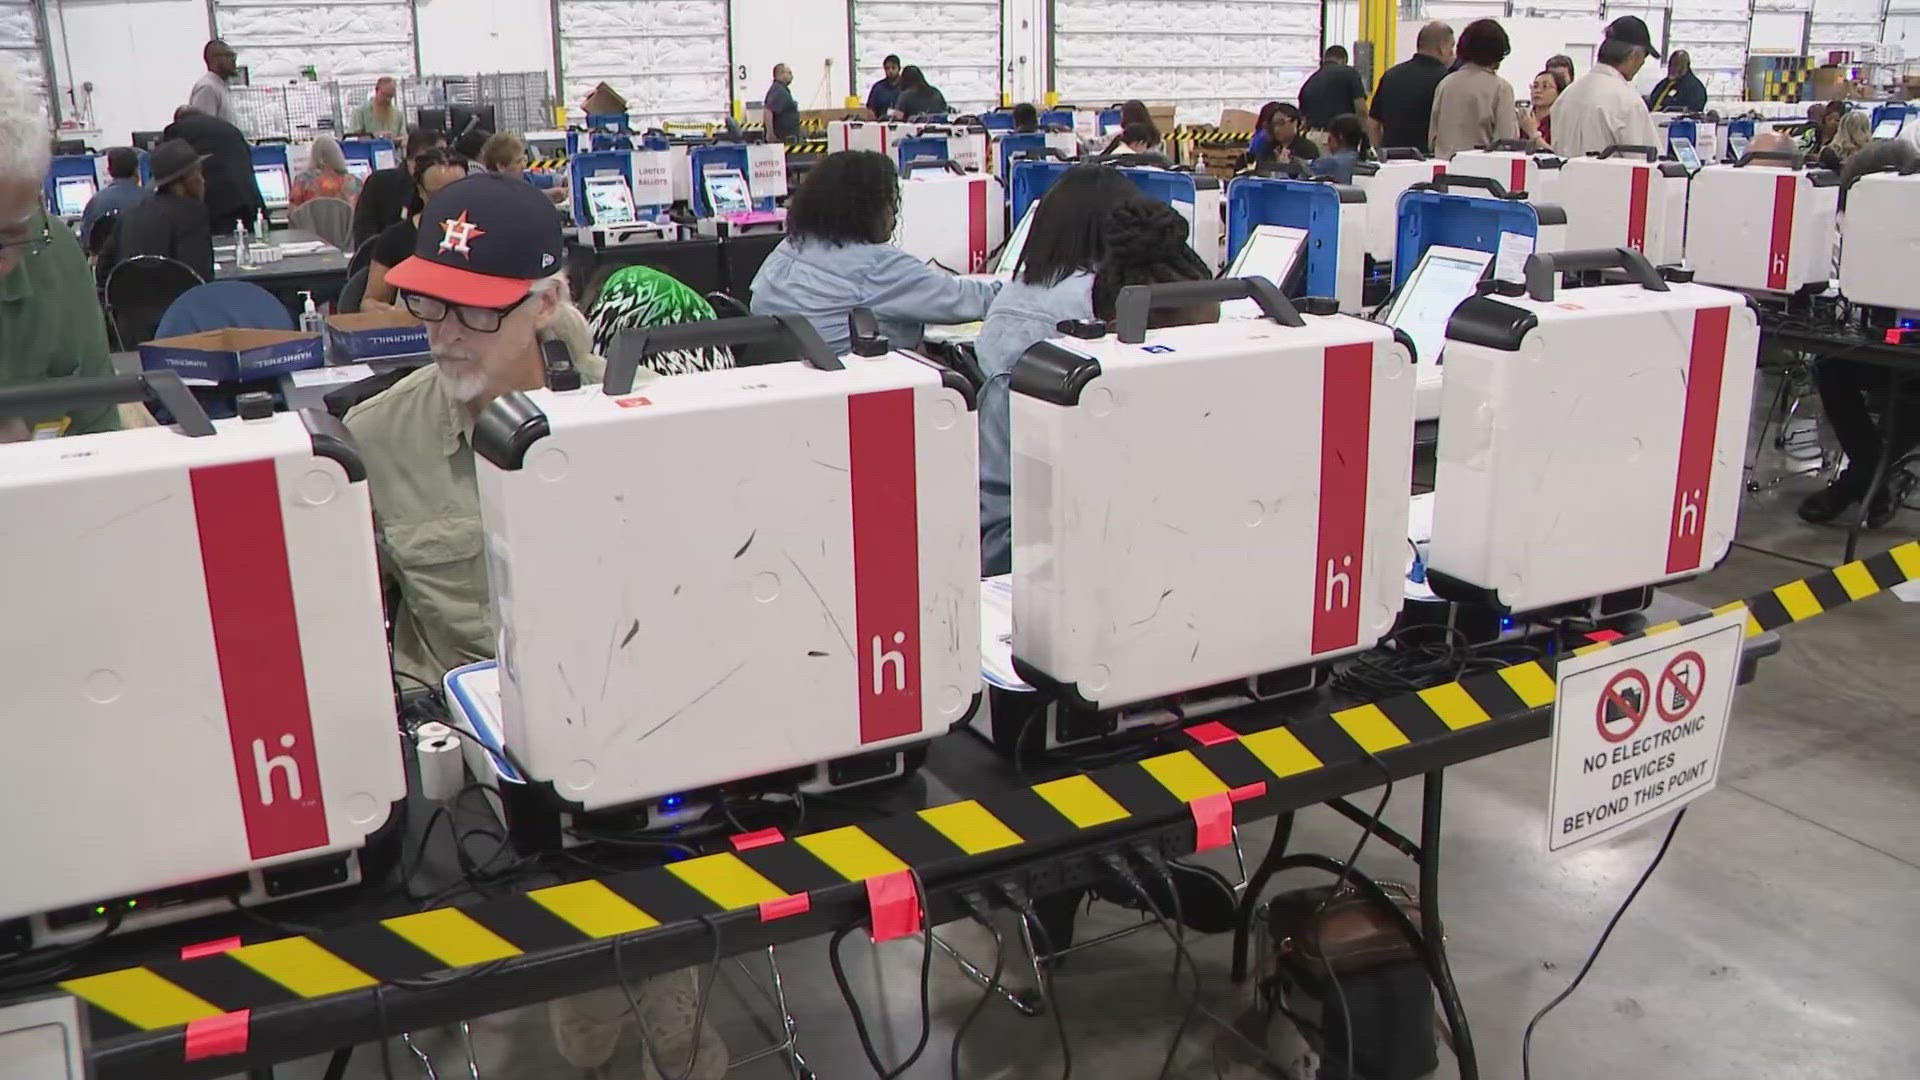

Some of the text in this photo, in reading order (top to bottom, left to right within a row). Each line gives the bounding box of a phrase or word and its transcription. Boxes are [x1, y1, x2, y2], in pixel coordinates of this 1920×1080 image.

[738, 65, 747, 80] 3
[638, 167, 666, 176] LIMITED
[754, 160, 780, 168] LIMITED
[754, 170, 781, 178] BALLOTS
[638, 178, 667, 186] BALLOTS
[439, 218, 478, 252] H
[370, 332, 430, 346] AMMERMILL
[256, 350, 313, 368] HAMMERMILL
[1678, 489, 1701, 538] hi
[1325, 555, 1352, 612] hi
[872, 631, 905, 695] hi
[1583, 716, 1705, 774] NO ELECTRONIC
[252, 733, 302, 806] hi
[1611, 752, 1676, 790] DEVICES
[1563, 760, 1708, 834] BEYOND THIS POINT
